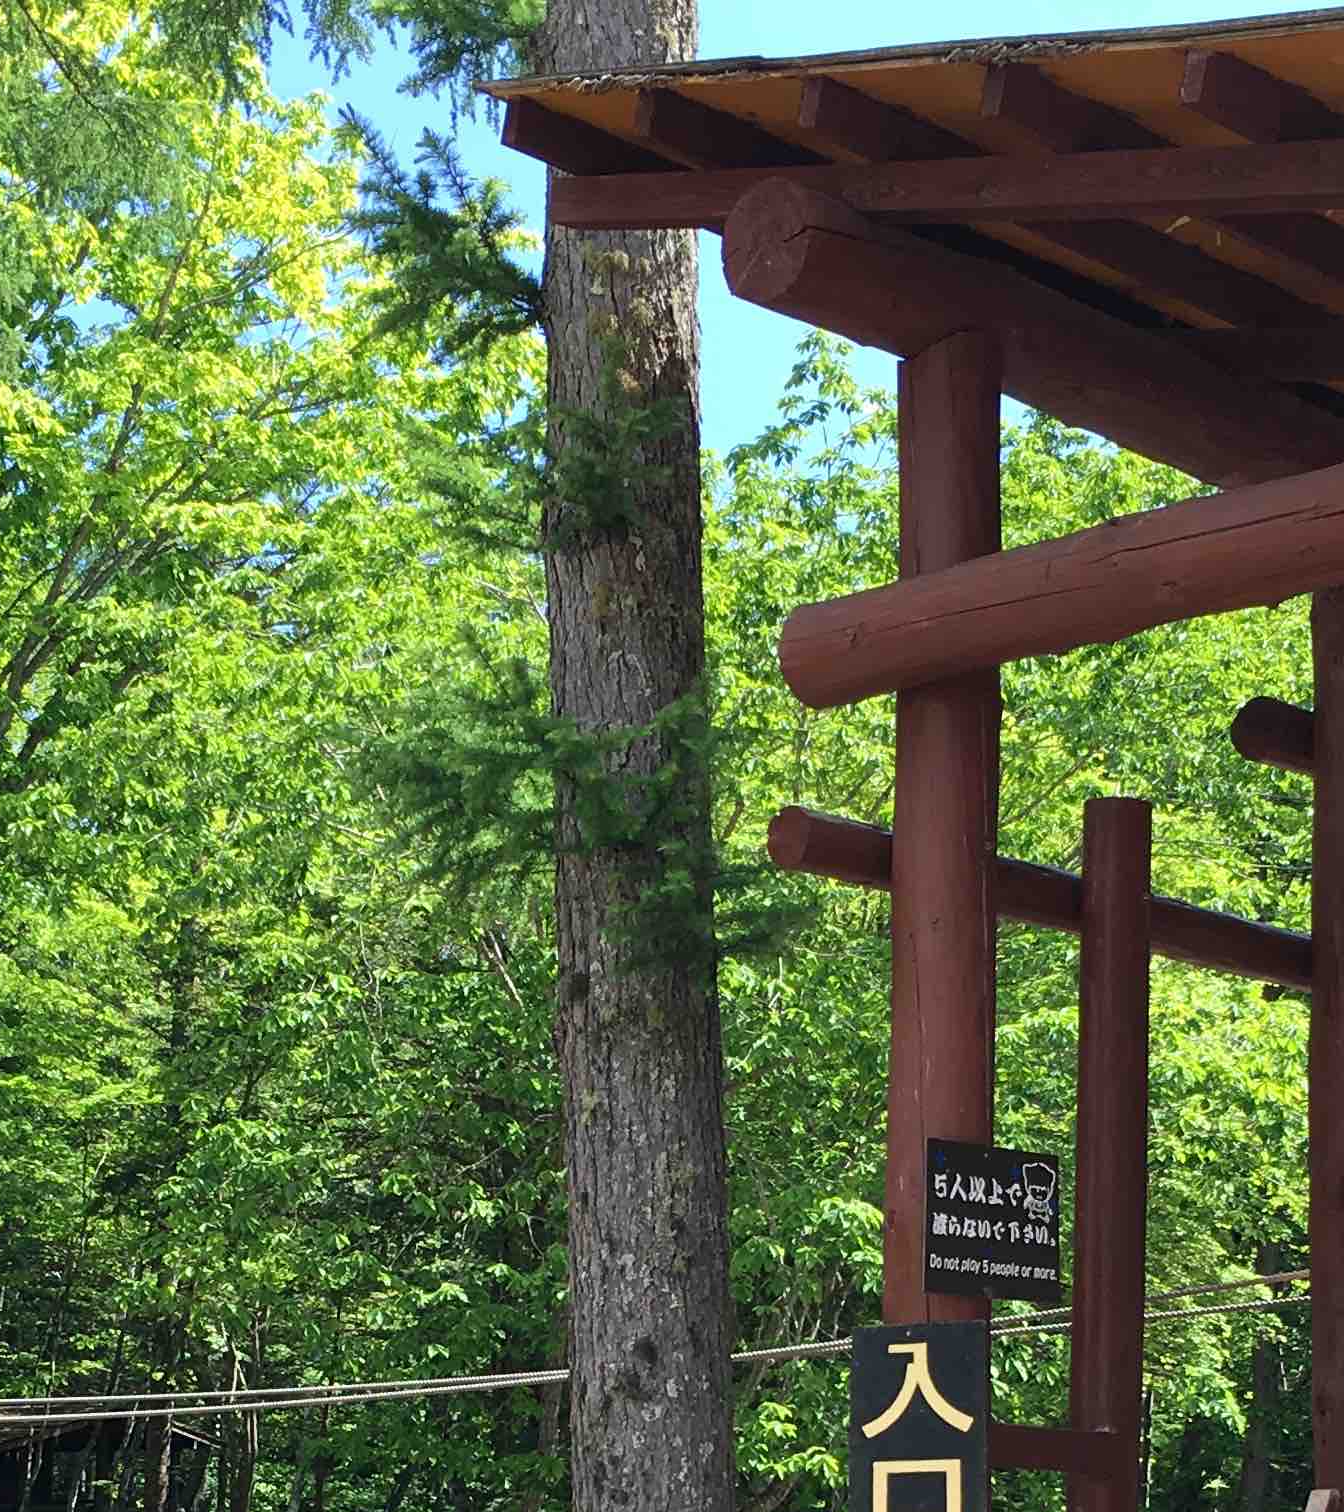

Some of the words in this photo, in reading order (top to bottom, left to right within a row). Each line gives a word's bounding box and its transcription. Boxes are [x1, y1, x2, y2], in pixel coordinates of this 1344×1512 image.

[934, 1173, 1023, 1207] 5人以上で
[929, 1253, 942, 1269] Do
[943, 1257, 959, 1271] not
[961, 1258, 981, 1275] play
[982, 1260, 989, 1273] 5
[990, 1262, 1019, 1278] people
[1021, 1266, 1032, 1278] or
